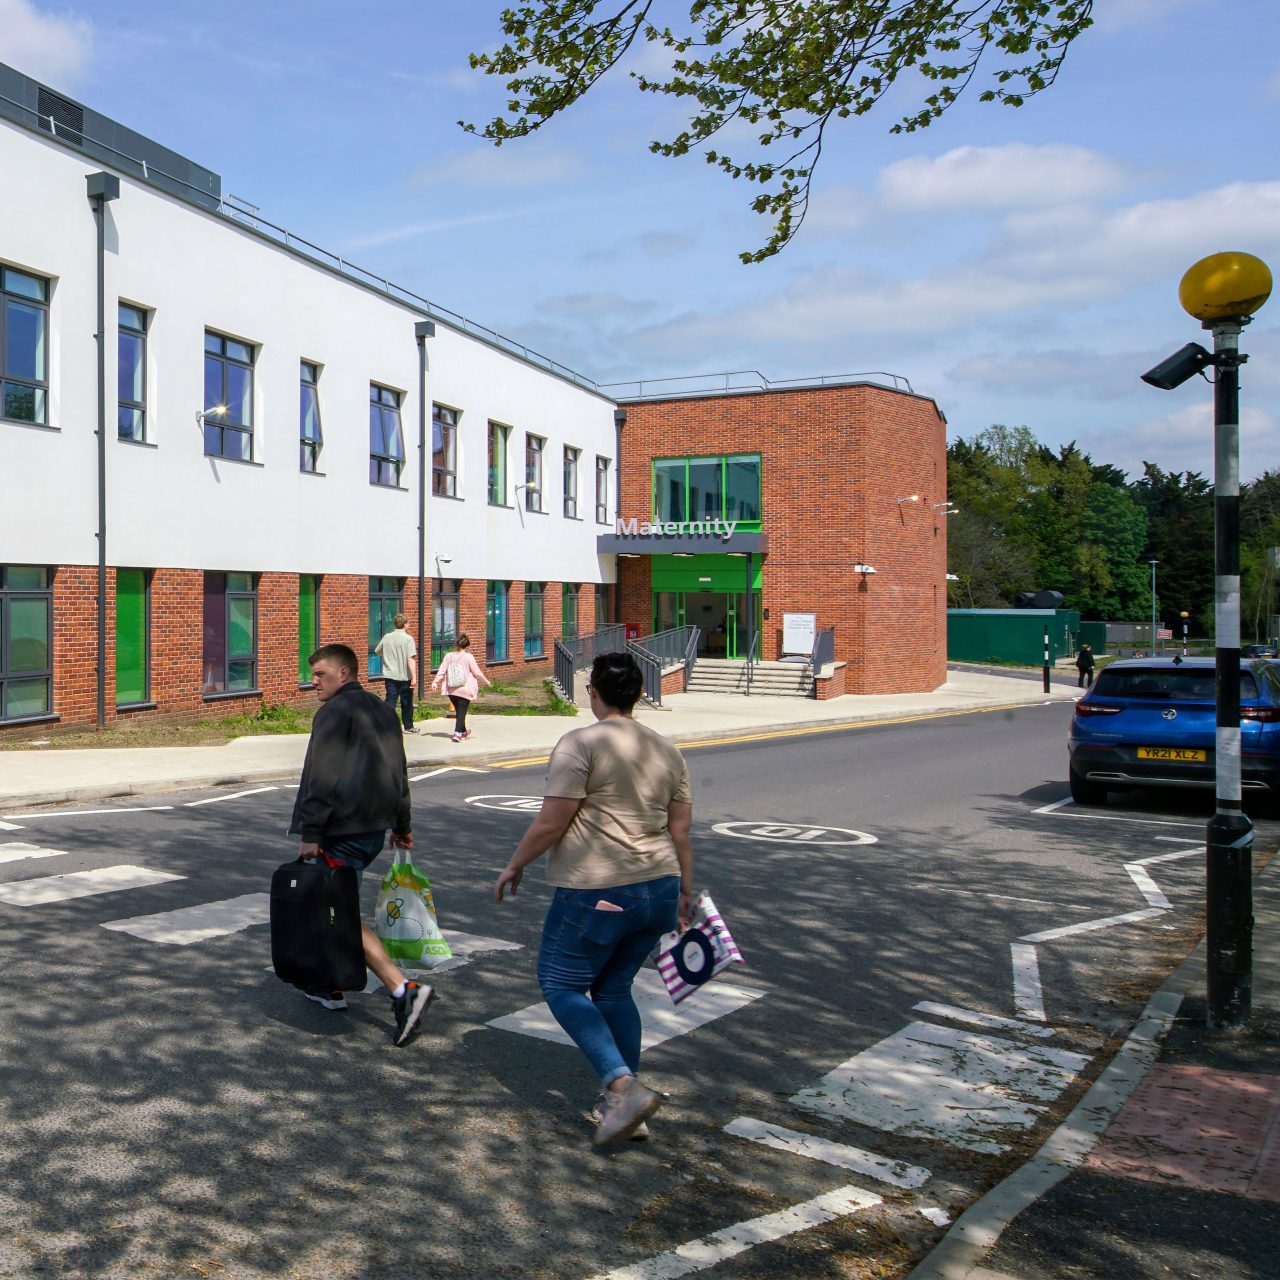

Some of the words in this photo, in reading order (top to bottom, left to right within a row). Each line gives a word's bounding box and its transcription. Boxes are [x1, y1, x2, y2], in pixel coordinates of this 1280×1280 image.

[616, 515, 736, 539] Maternity
[1144, 748, 1172, 758] YR21
[1174, 750, 1200, 760] XLZ
